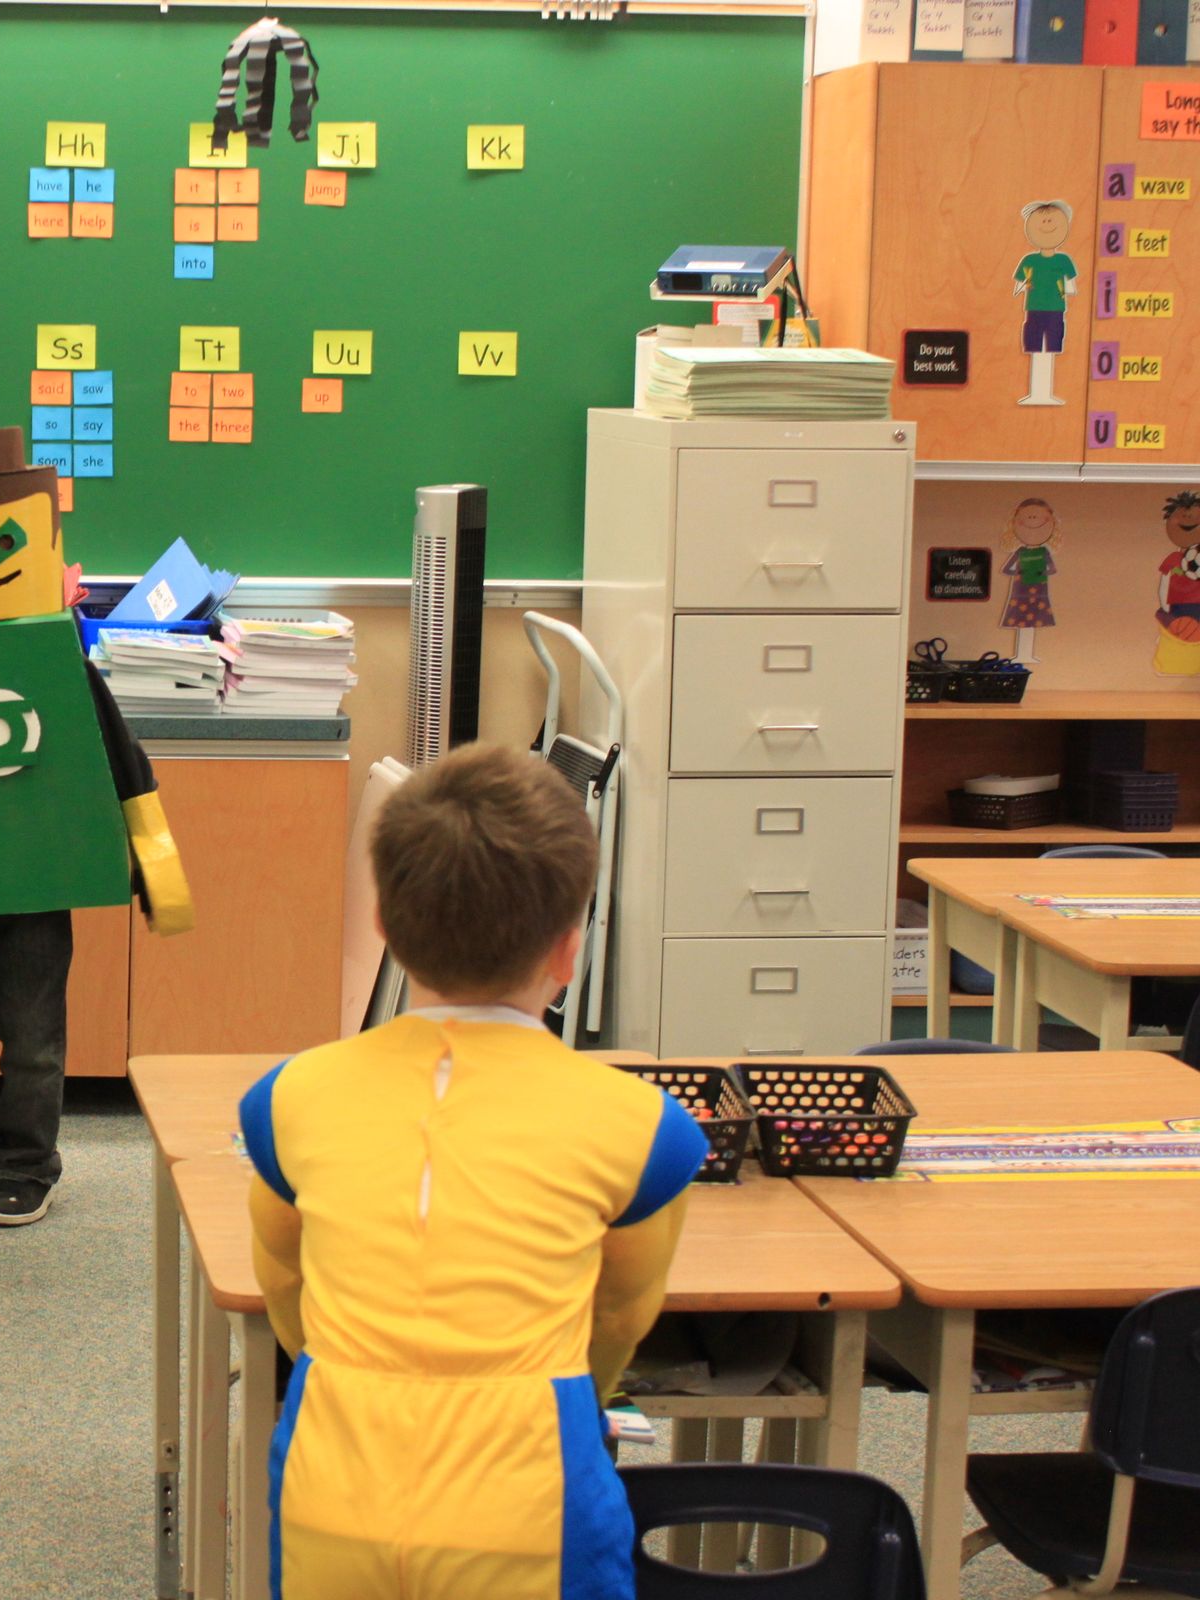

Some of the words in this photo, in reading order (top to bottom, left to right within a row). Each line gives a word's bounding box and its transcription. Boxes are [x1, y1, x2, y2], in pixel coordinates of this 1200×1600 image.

[1165, 89, 1200, 115] Long
[1151, 118, 1180, 138] say
[58, 133, 95, 158] Hh
[332, 134, 361, 165] Jj
[481, 136, 512, 161] Kk
[36, 180, 64, 192] have
[86, 180, 102, 192] he
[189, 182, 200, 192] it
[234, 182, 243, 192] I
[309, 184, 342, 198] jump
[1141, 180, 1186, 195] wave
[34, 215, 65, 227] here
[79, 215, 107, 230] help
[189, 220, 201, 231] is
[233, 220, 244, 230] in
[1136, 232, 1168, 252] feet
[182, 257, 207, 269] into
[1125, 295, 1171, 316] swipe
[51, 337, 83, 361] Ss
[195, 338, 225, 362] Tt
[326, 342, 360, 366] Uu
[473, 343, 504, 367] Vv
[919, 343, 933, 356] Do
[934, 345, 956, 358] your
[913, 359, 933, 372] best
[934, 360, 960, 372] work.
[1122, 357, 1160, 379] poke
[38, 383, 65, 395] said
[82, 384, 104, 394] saw
[184, 386, 198, 396] to
[221, 386, 245, 397] two
[314, 392, 330, 404] up
[45, 421, 58, 430] so
[82, 421, 104, 433] say
[178, 419, 201, 432] the
[214, 419, 251, 433] three
[1124, 425, 1161, 448] puke
[37, 456, 67, 467] soon
[82, 454, 104, 466] she
[948, 555, 972, 566] Listen
[944, 569, 977, 582] carefully
[934, 584, 943, 594] to
